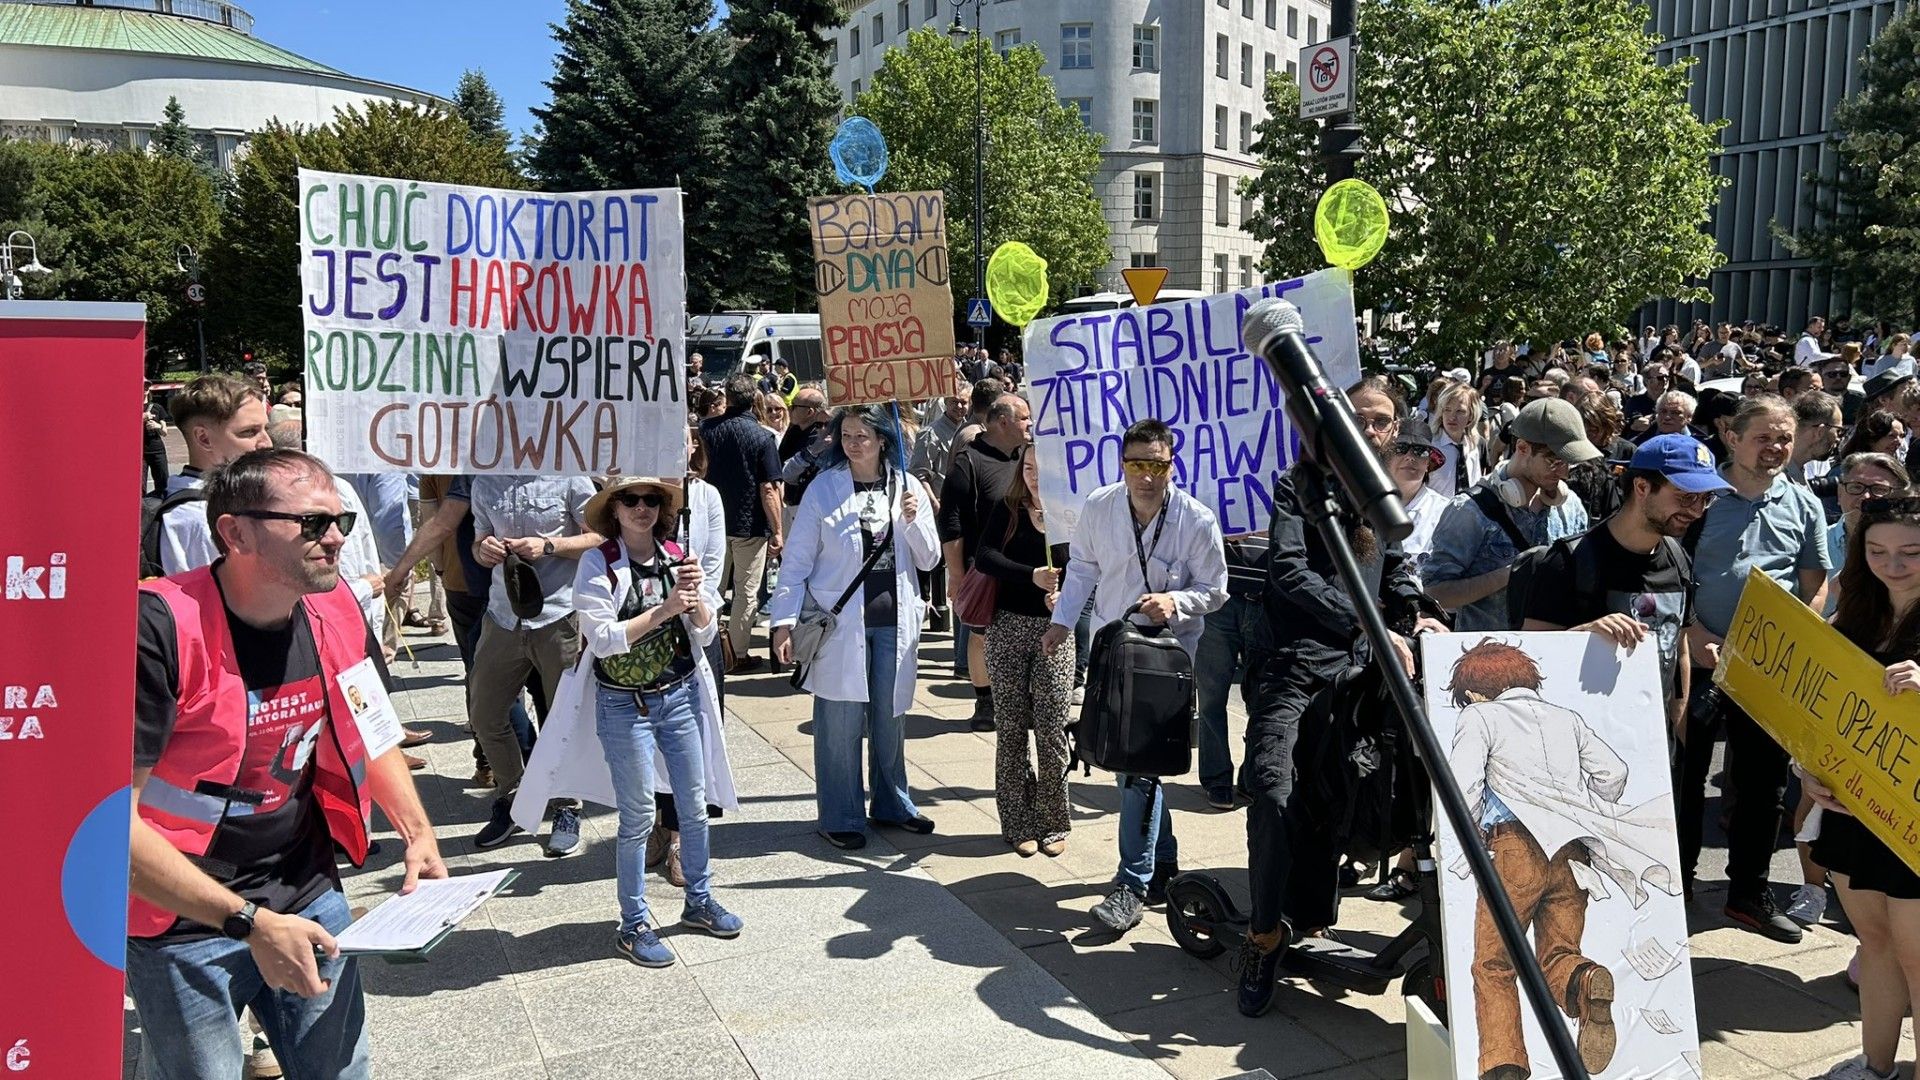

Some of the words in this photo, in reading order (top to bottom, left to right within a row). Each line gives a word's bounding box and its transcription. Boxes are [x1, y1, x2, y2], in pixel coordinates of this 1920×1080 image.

[305, 182, 428, 253] CHOĆ
[446, 193, 659, 261] DOKTORAT
[190, 287, 206, 298] 30
[308, 249, 441, 323] JEST
[449, 257, 655, 345] HARÓWKĄ
[847, 249, 915, 293] DNA
[306, 329, 481, 397] RODZINA
[498, 335, 679, 402] WSPIERA
[907, 357, 957, 398] DNA
[369, 393, 622, 475] GOTÓWKĄ
[0, 552, 66, 599] ki
[248, 707, 297, 726] EKTORA
[249, 692, 307, 715] ROTEST
[1735, 605, 1797, 694] PASJĄ
[1792, 656, 1838, 721] NIE
[1836, 690, 1918, 786] OPŁACĘ
[1818, 743, 1847, 774] 3%
[1845, 770, 1863, 800] dla
[1867, 797, 1901, 830] nauki
[1903, 820, 1918, 845] to
